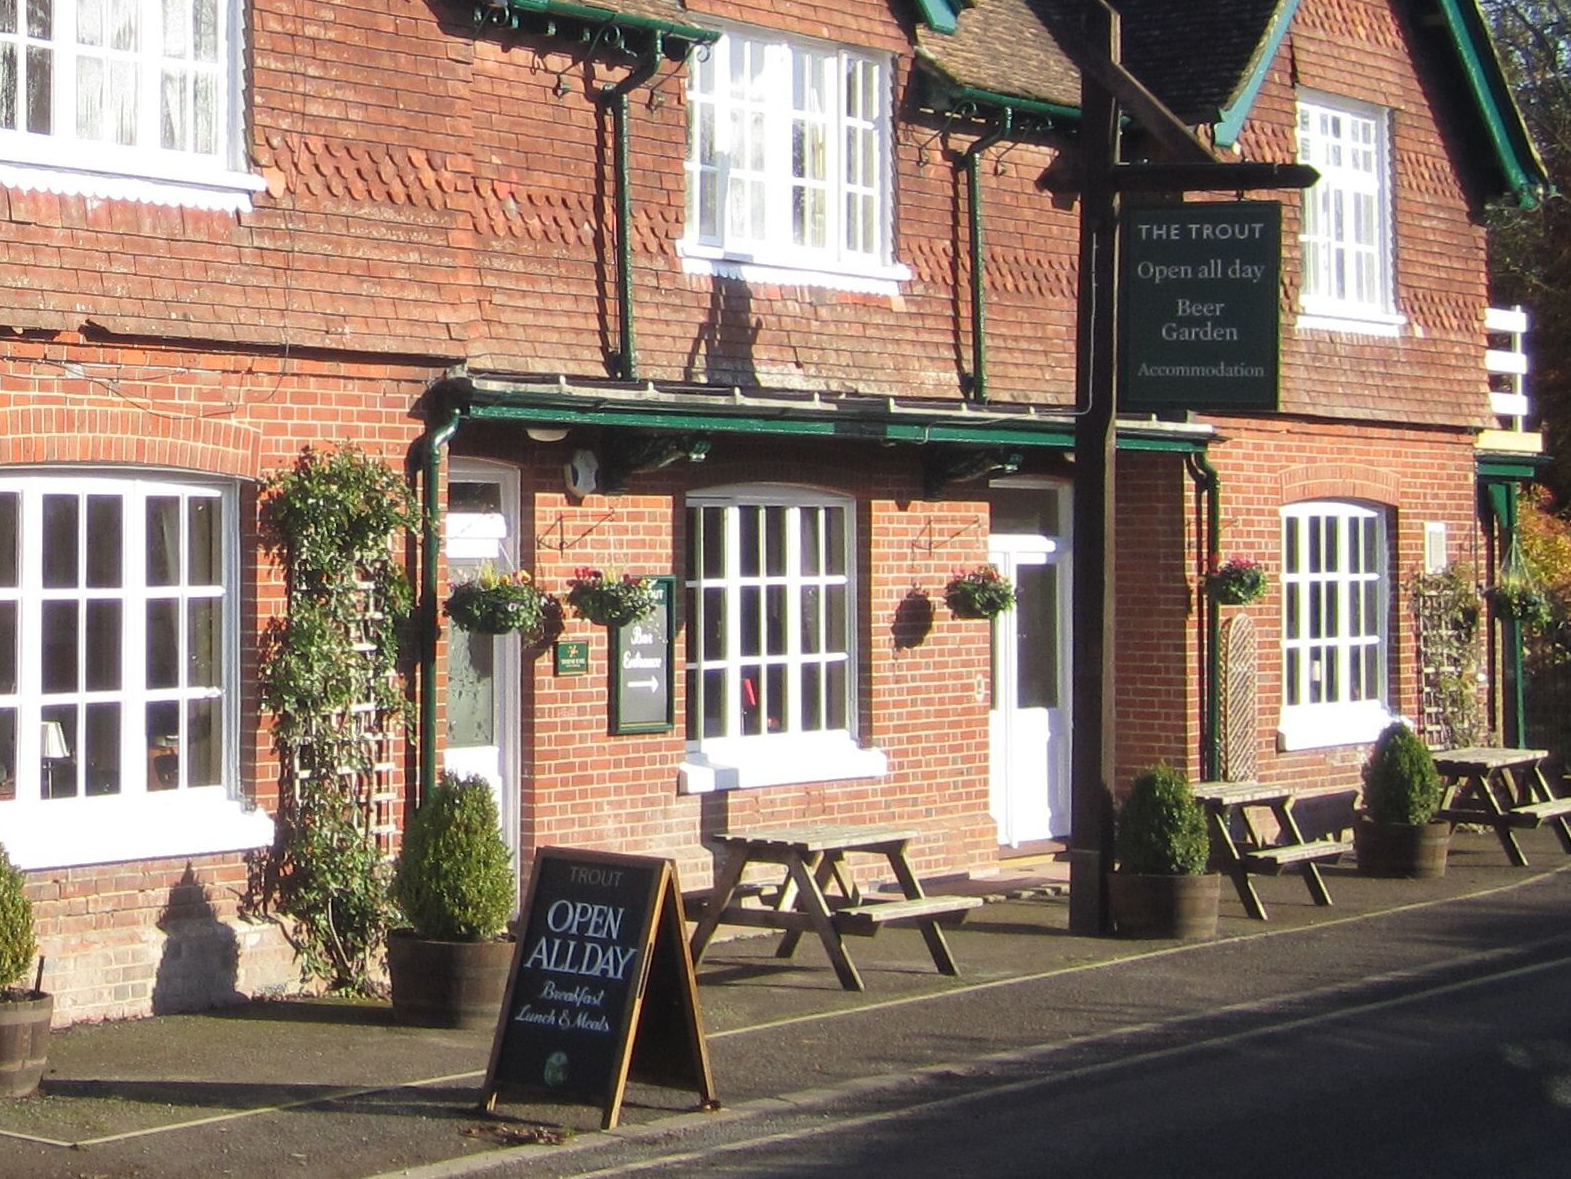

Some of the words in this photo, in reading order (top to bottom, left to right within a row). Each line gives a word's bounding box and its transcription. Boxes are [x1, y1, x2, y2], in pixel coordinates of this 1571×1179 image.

[1137, 223, 1181, 240] THE
[1187, 222, 1265, 240] TROUT
[1137, 260, 1192, 284] Open
[1197, 258, 1222, 279] all
[1228, 258, 1266, 283] day
[1177, 298, 1225, 317] Beer
[1161, 322, 1239, 341] Garden
[1137, 361, 1265, 378] Accommodation
[570, 866, 624, 887] TROUT
[547, 899, 625, 940] OPEN
[524, 936, 579, 974] ALL
[578, 942, 638, 980] DAY
[538, 980, 605, 1007] Breakfast
[514, 1004, 556, 1025] Lunch
